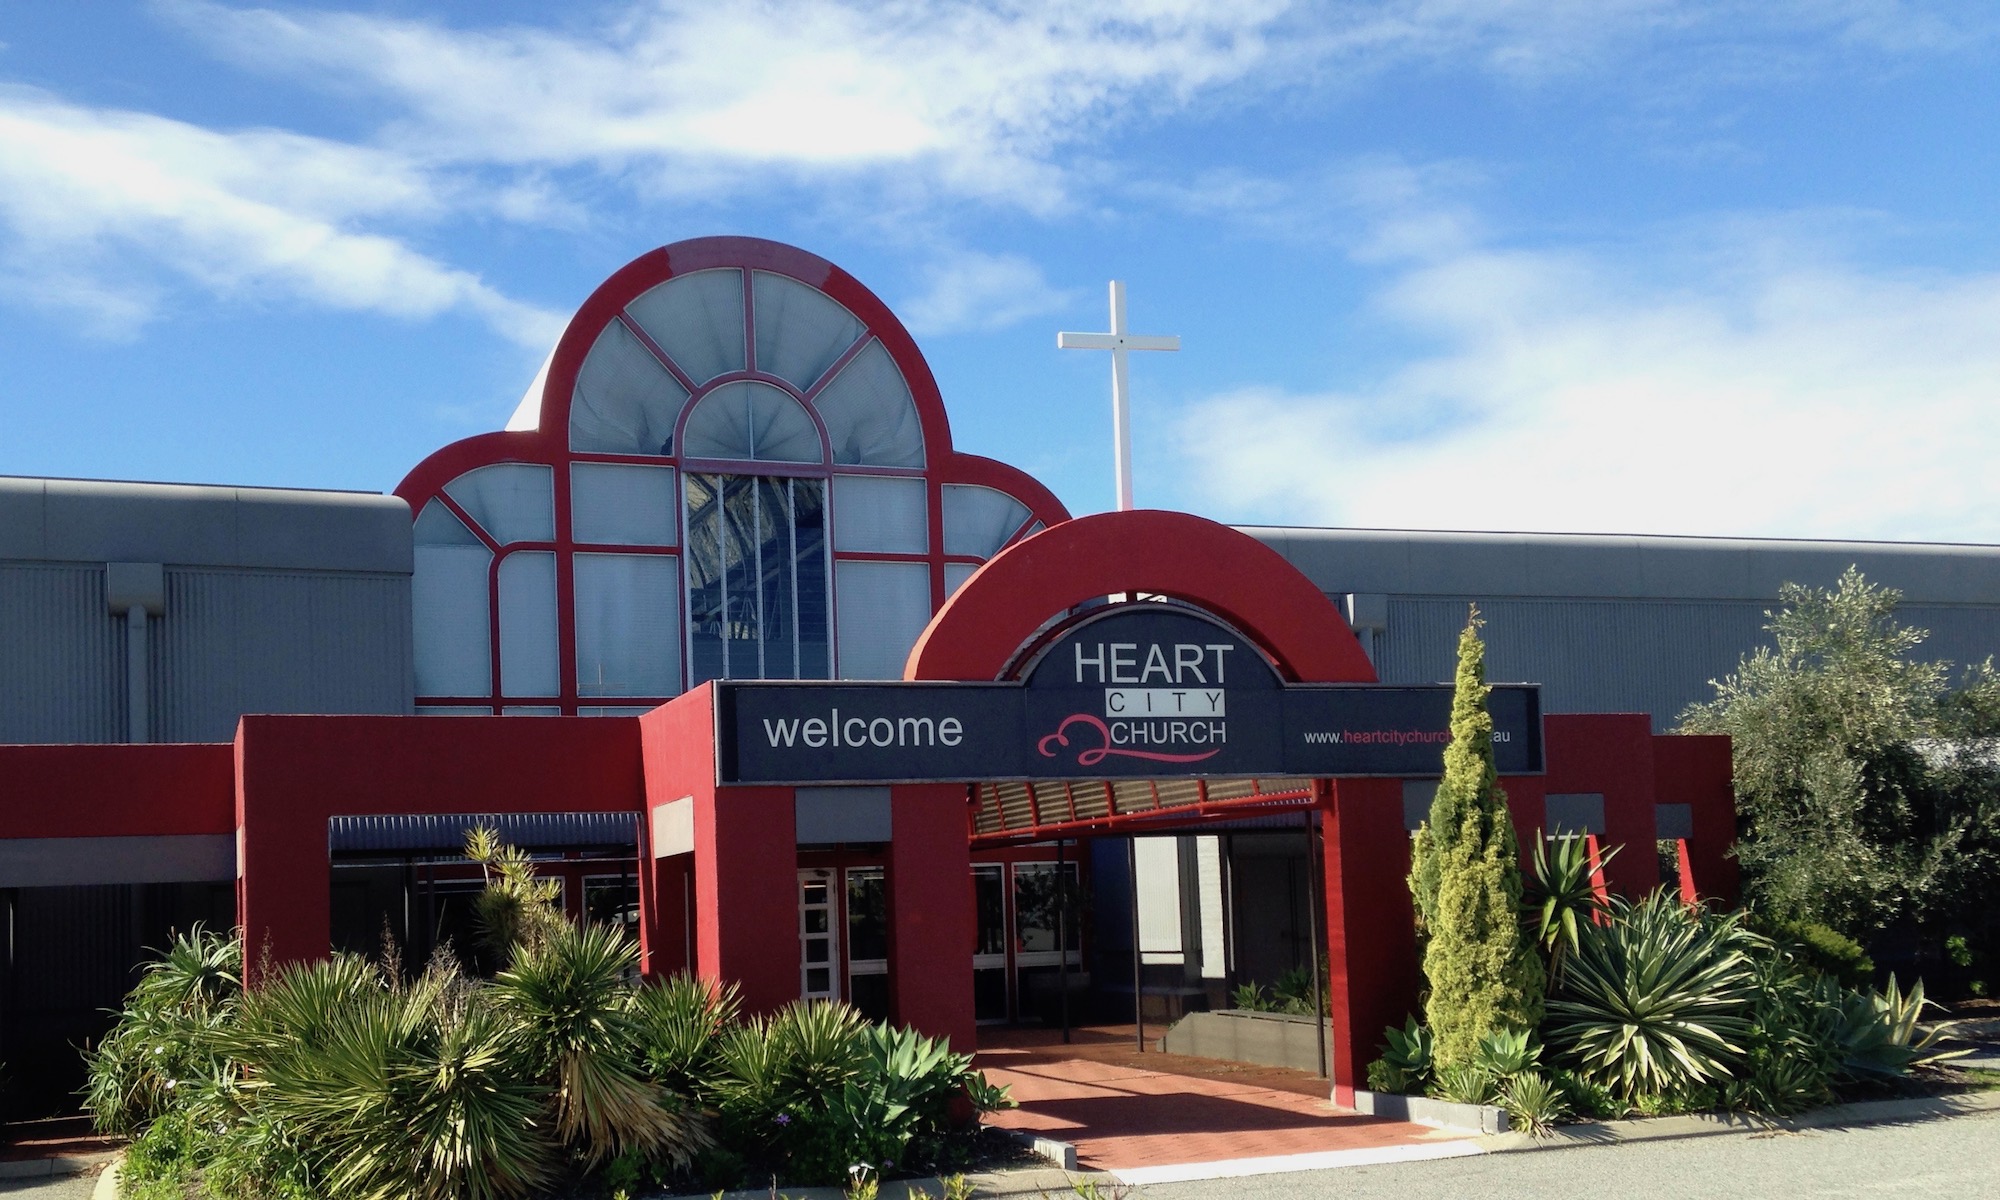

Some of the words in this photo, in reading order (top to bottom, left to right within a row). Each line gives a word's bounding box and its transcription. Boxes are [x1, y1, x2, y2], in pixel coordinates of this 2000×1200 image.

[1074, 642, 1235, 684] HEART
[1108, 692, 1221, 713] CITY
[763, 708, 964, 747] welcome
[1110, 721, 1227, 744] CHURCH
[1304, 729, 1511, 746] www.heartcitychurch.au
